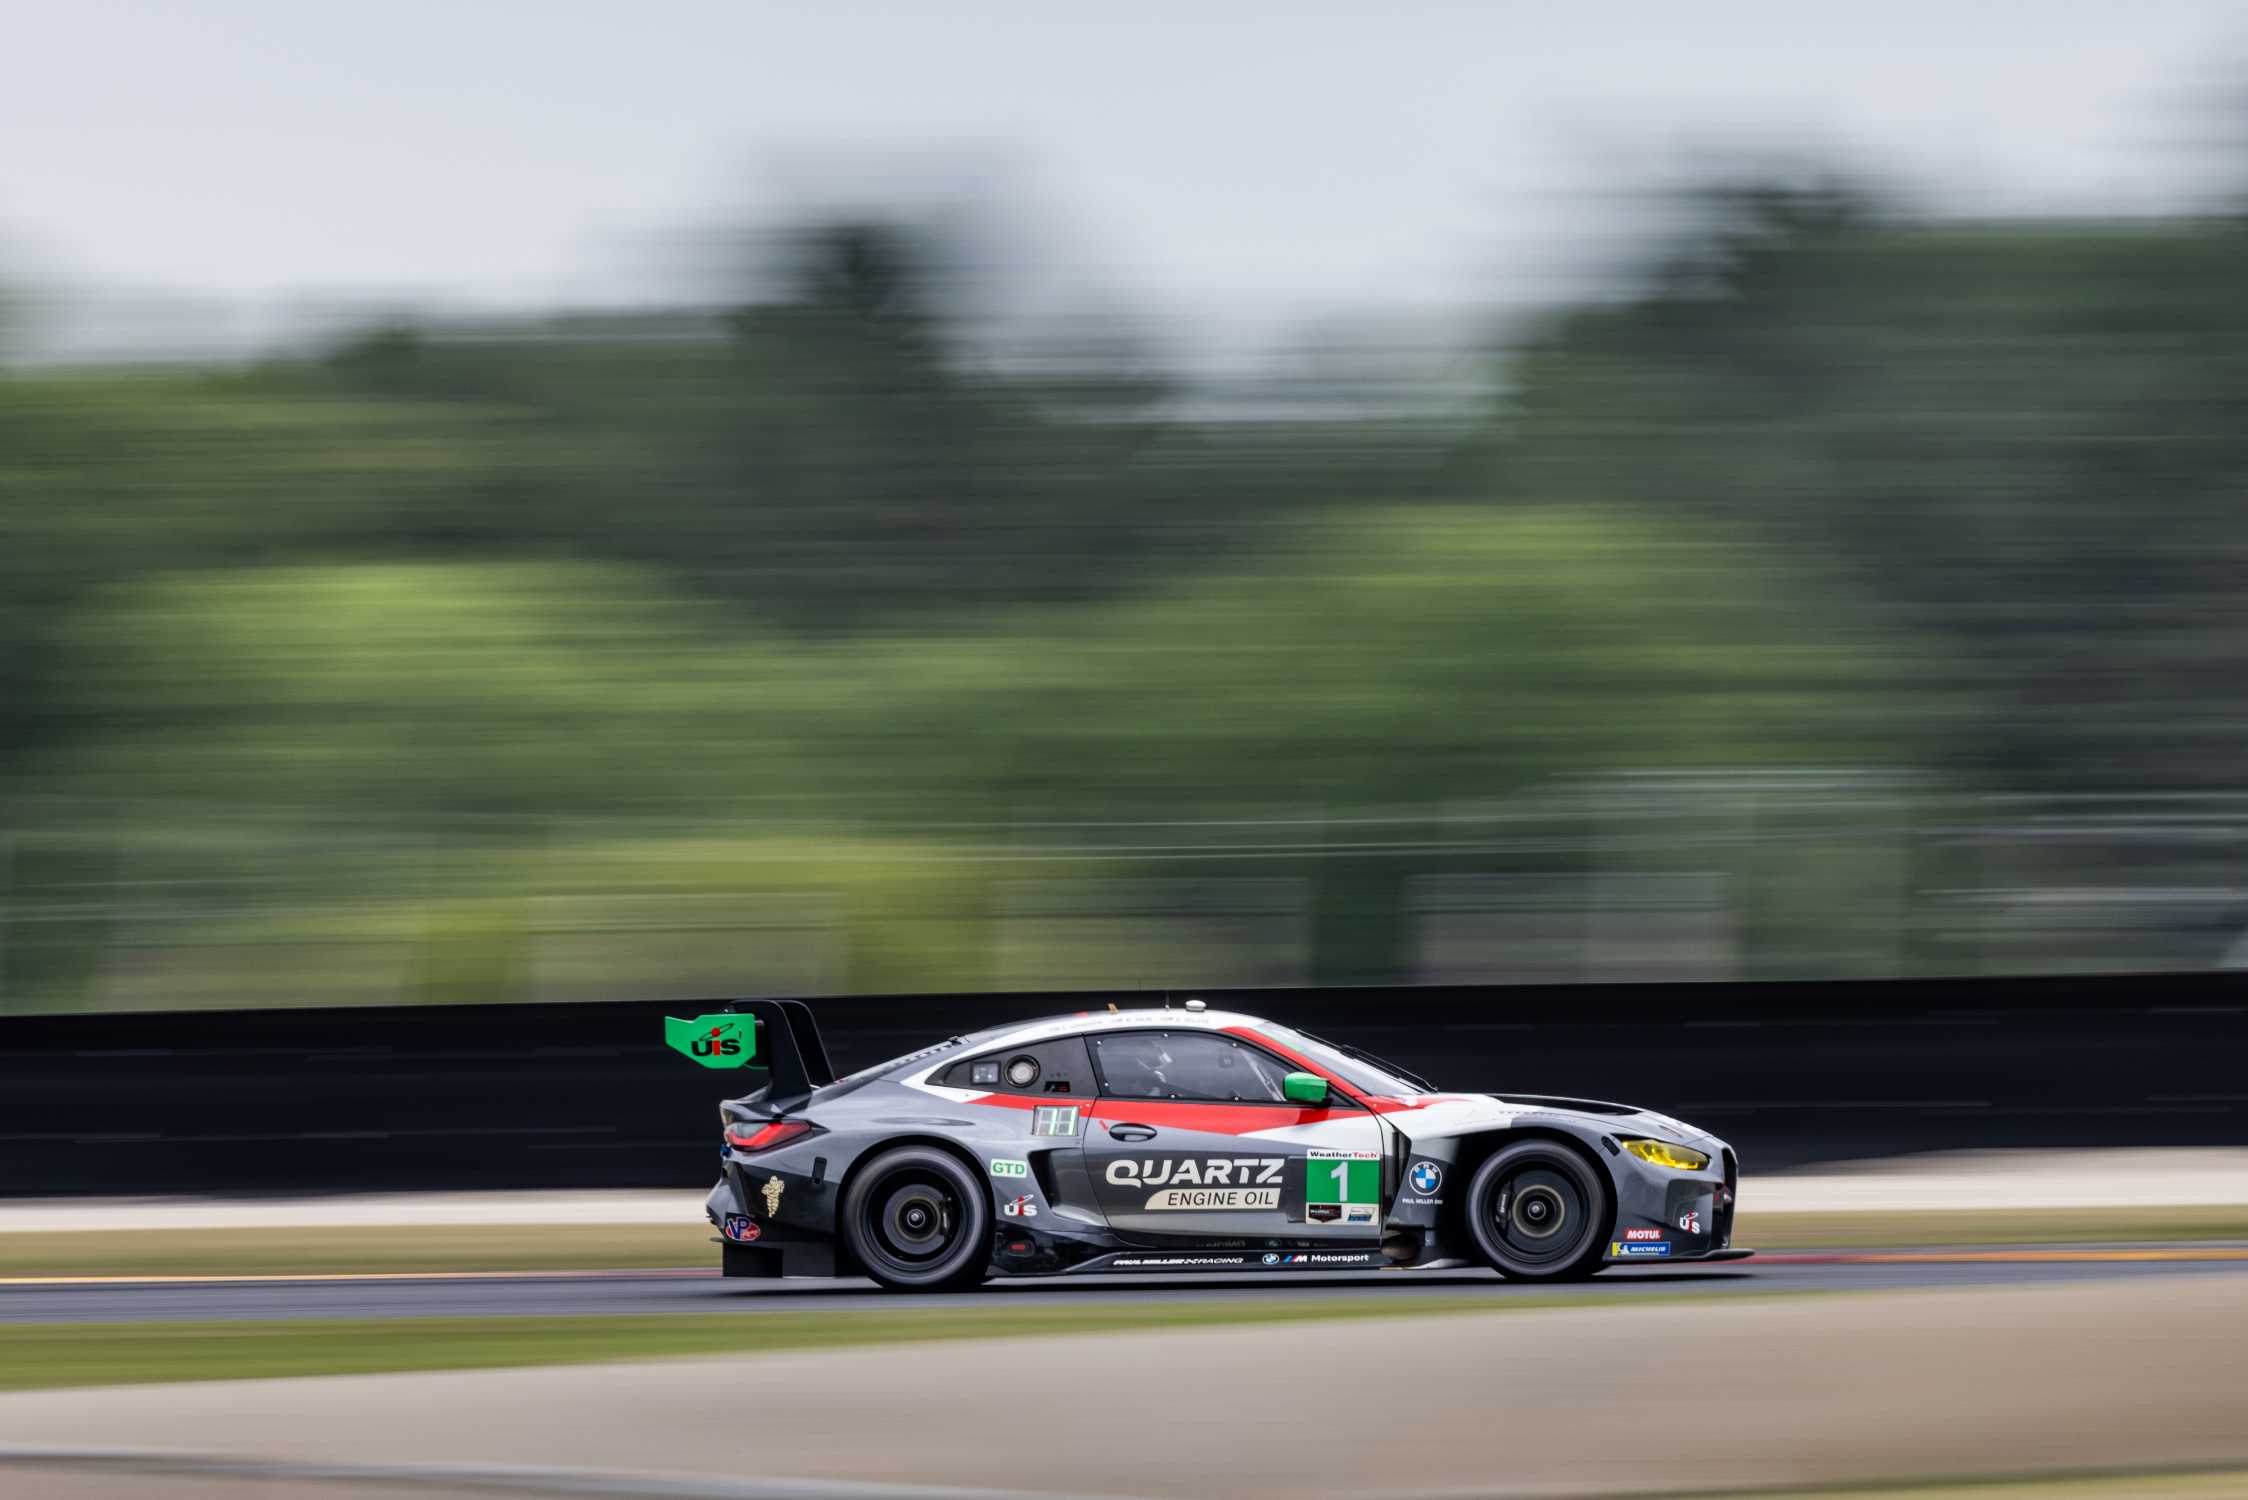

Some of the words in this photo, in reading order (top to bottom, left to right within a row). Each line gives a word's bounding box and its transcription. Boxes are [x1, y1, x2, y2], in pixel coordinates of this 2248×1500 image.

[992, 1162, 1025, 1175] GTD
[1105, 1158, 1285, 1189] QUARTZ
[1331, 1161, 1349, 1202] 1
[1167, 1192, 1238, 1207] ENGINE
[1244, 1191, 1274, 1206] OIL
[1626, 1230, 1662, 1239] MOTUL
[1311, 1254, 1370, 1264] Motorsport
